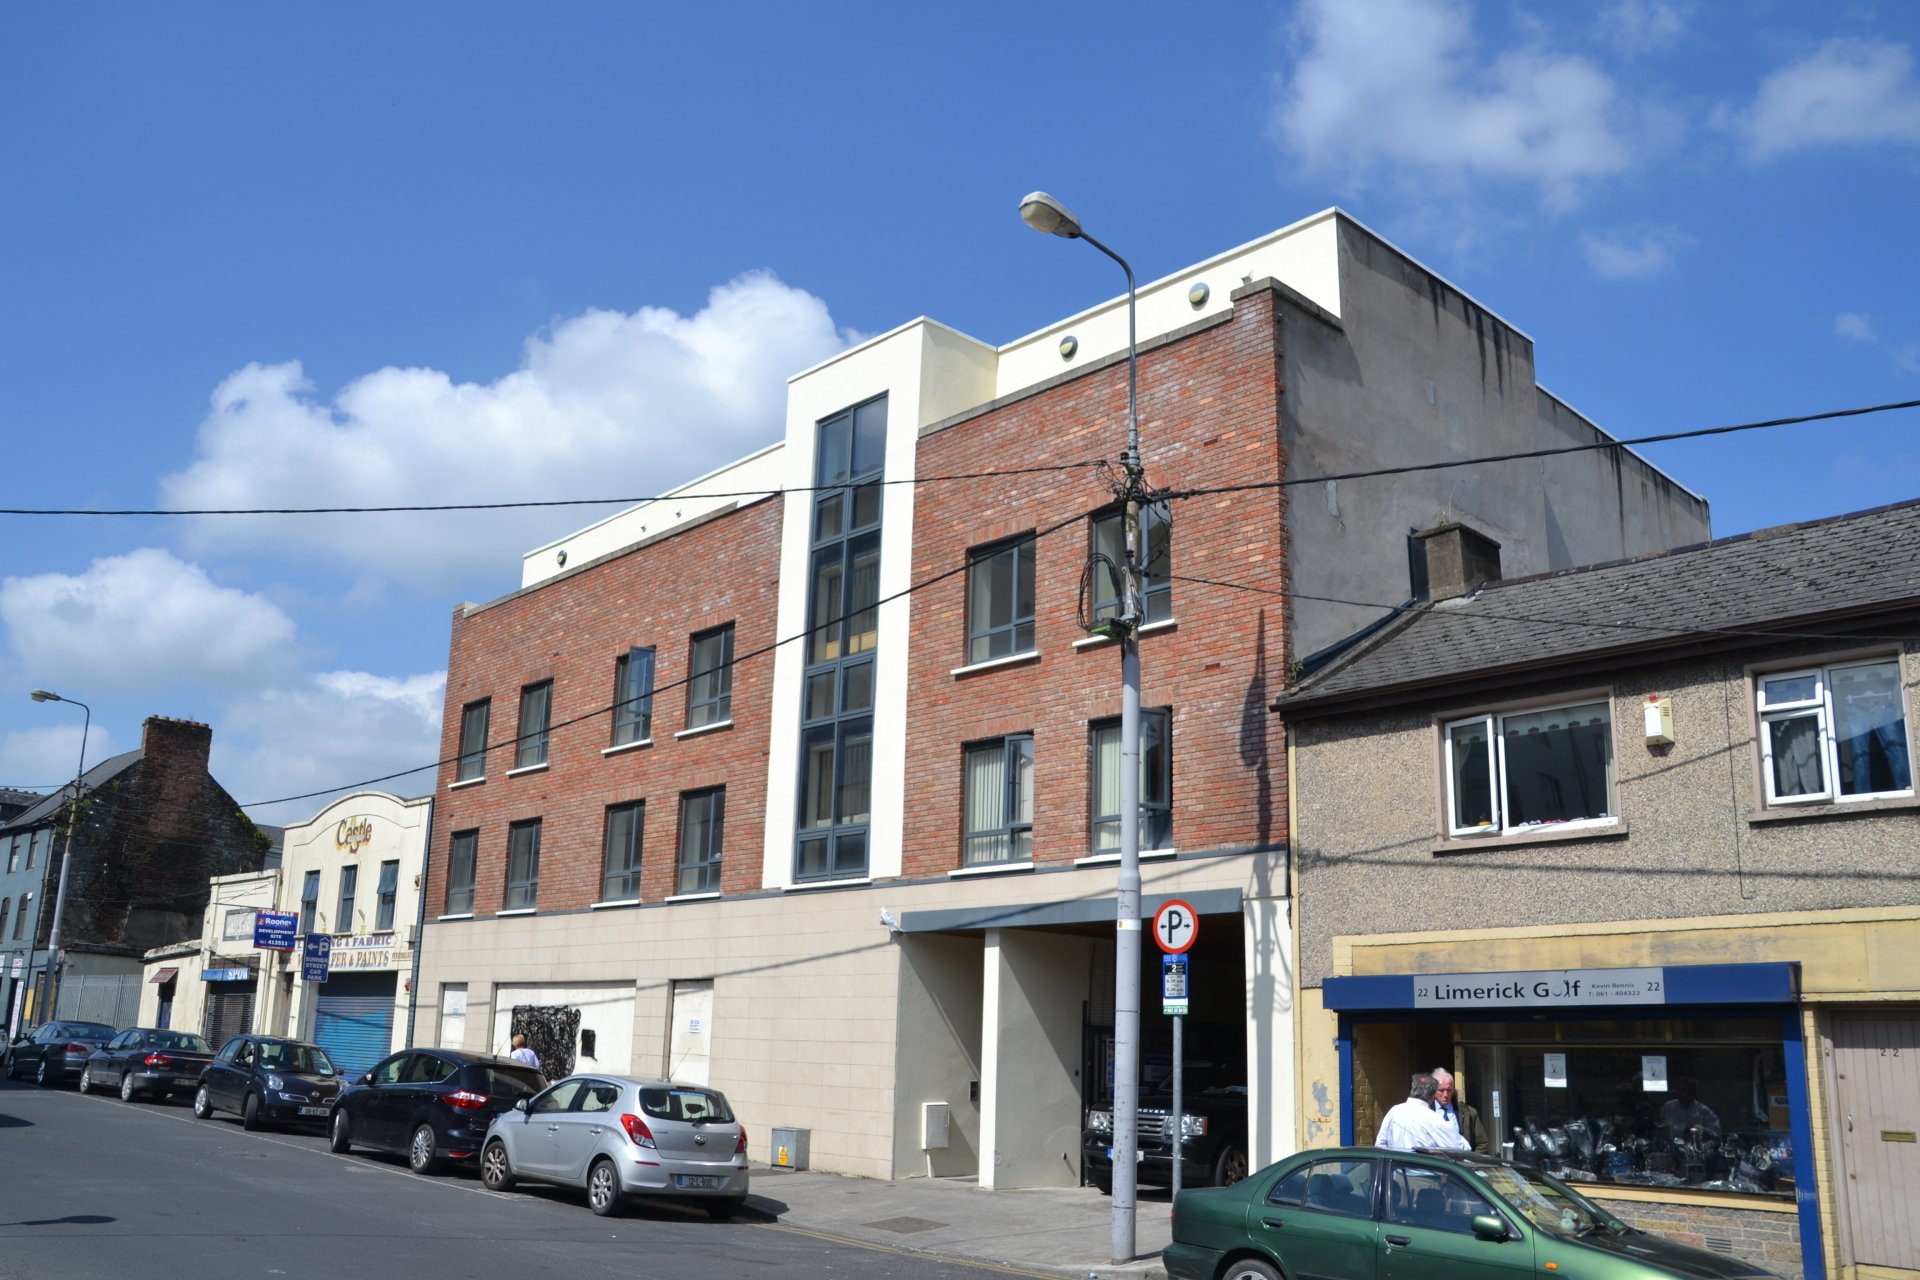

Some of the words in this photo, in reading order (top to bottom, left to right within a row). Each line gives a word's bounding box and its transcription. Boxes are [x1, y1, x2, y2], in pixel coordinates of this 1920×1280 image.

[1168, 910, 1182, 943] P
[352, 935, 392, 947] FABRIC
[355, 950, 390, 968] PAINTS
[1171, 964, 1177, 973] 2
[1417, 988, 1429, 998] 22
[1434, 982, 1526, 1000] Limerick
[1533, 979, 1581, 998] Golf
[1646, 981, 1661, 992] 22
